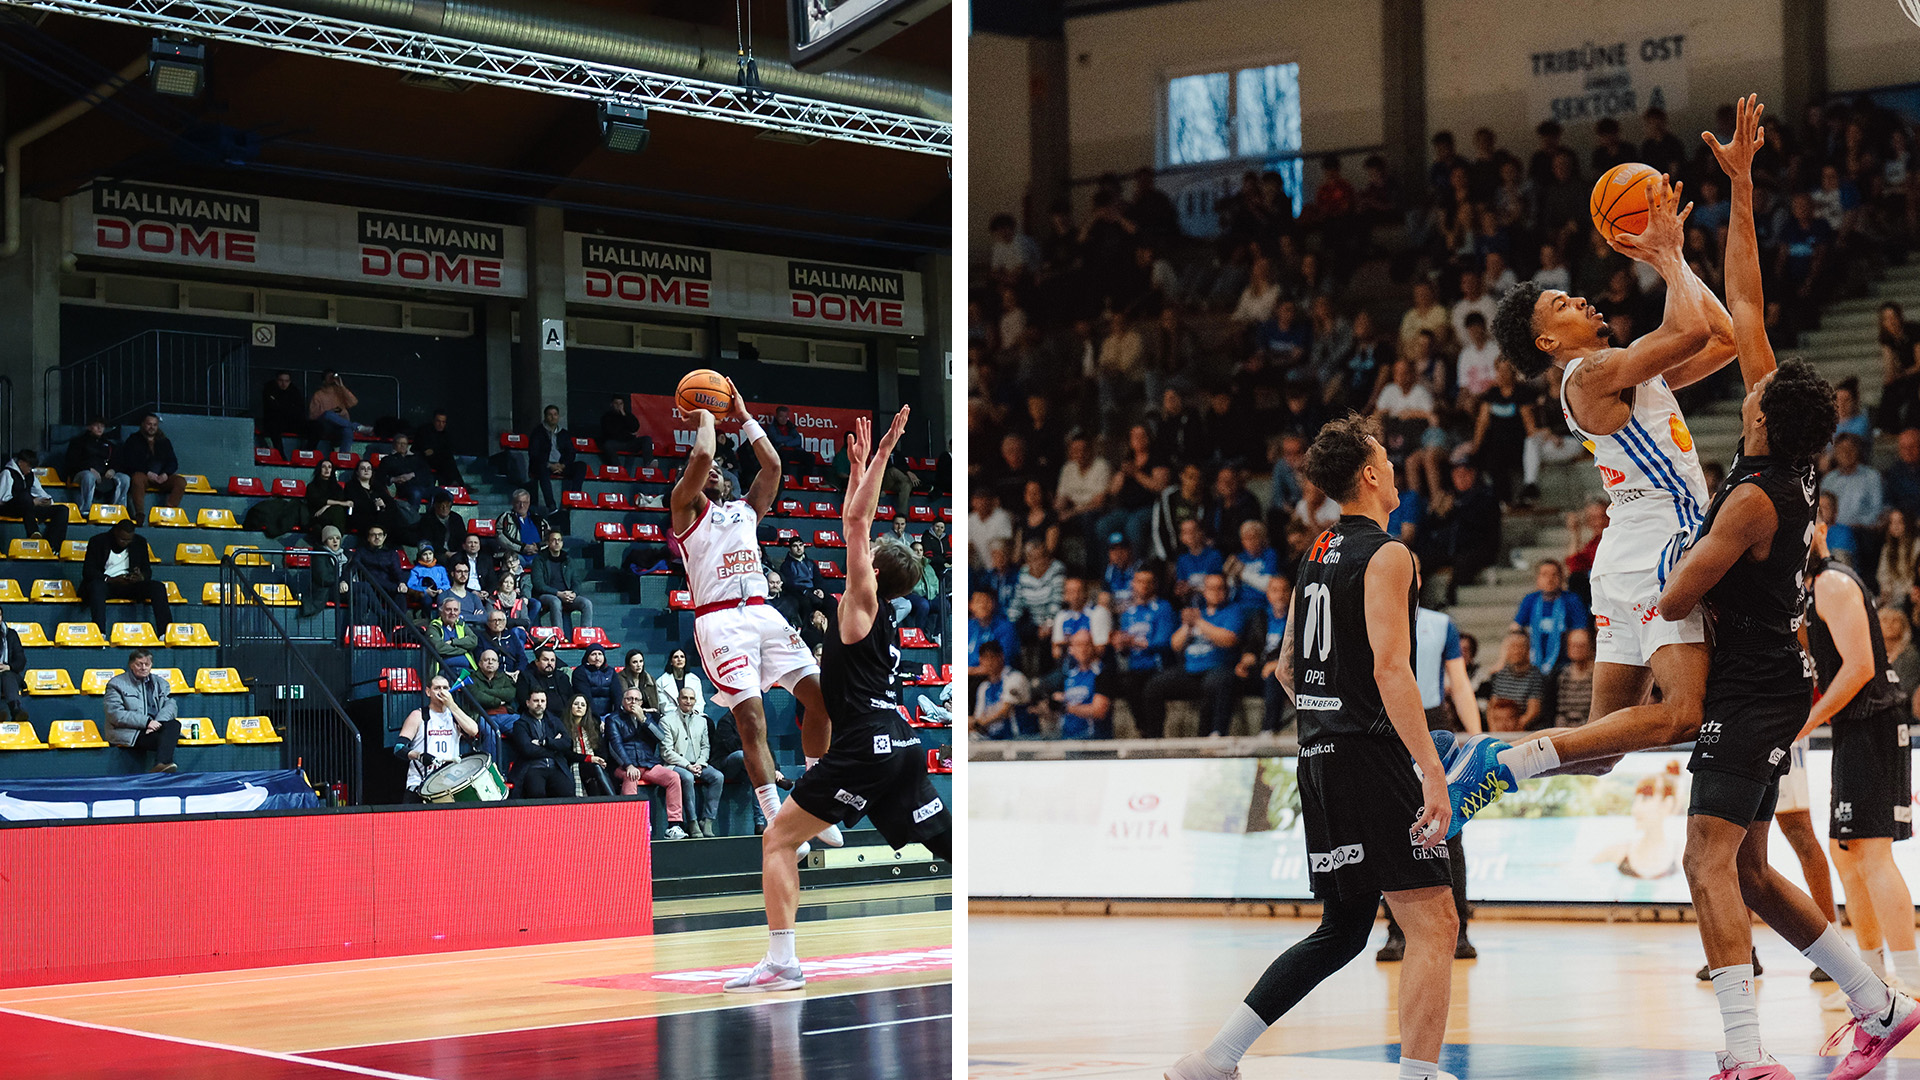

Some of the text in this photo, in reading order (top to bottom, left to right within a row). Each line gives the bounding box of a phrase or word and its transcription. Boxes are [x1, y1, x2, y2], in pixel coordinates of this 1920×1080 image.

[1640, 35, 1685, 62] OST
[102, 188, 251, 224] HALLMANN
[97, 218, 256, 264] DOME
[366, 219, 497, 252] HALLMANN
[362, 247, 501, 288] DOME
[589, 244, 705, 274] HALLMANN
[585, 271, 710, 308] DOME
[794, 267, 898, 295] HALLMANN
[792, 293, 903, 327] DOME
[546, 328, 561, 346] A
[695, 392, 728, 410] Wilson
[794, 412, 838, 429] leben.
[1304, 669, 1326, 686] OPEL
[435, 740, 447, 753] 10
[1104, 820, 1169, 839] AVITA
